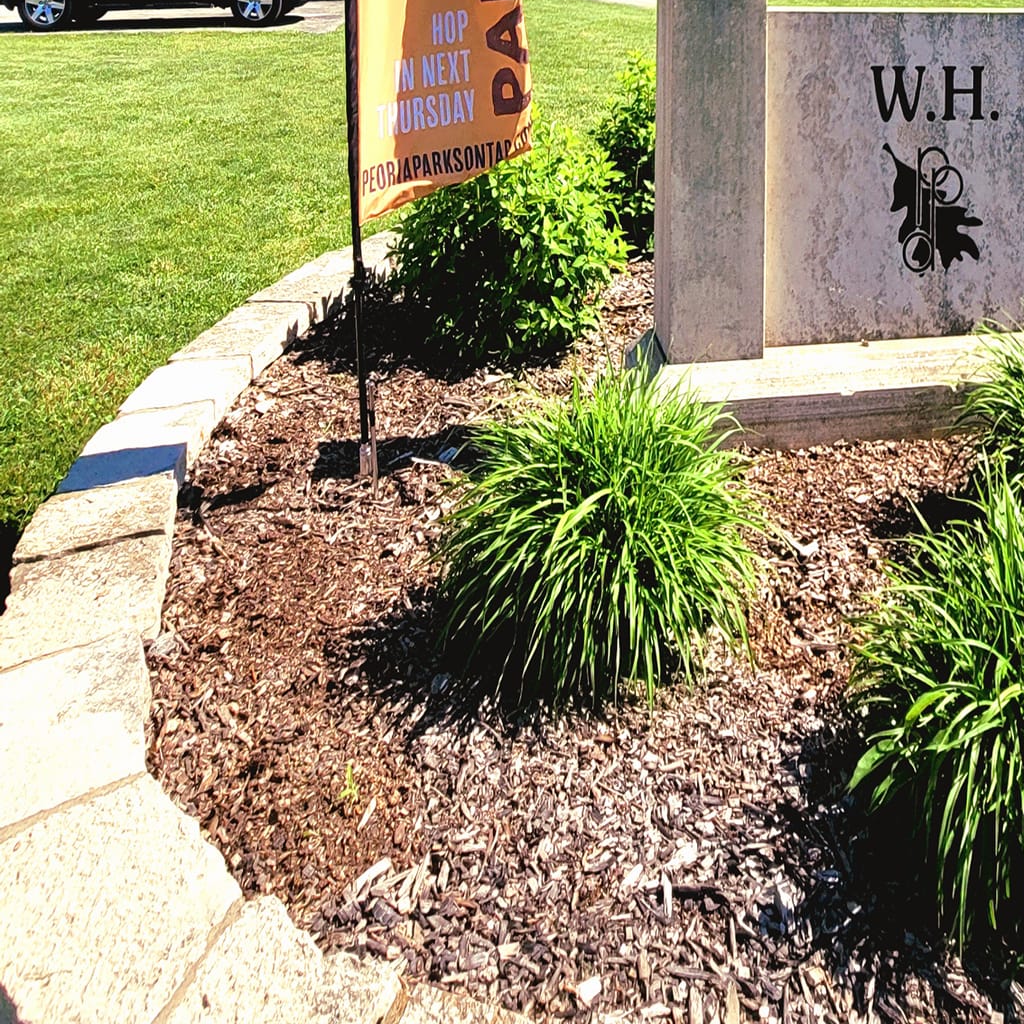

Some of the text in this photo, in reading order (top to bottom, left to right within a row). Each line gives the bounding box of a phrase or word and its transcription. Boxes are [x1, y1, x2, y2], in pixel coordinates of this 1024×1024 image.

[431, 9, 469, 46] HOP
[394, 49, 472, 94] IN NEXT
[870, 65, 999, 123] W.H.
[376, 87, 476, 140] THURSDAY
